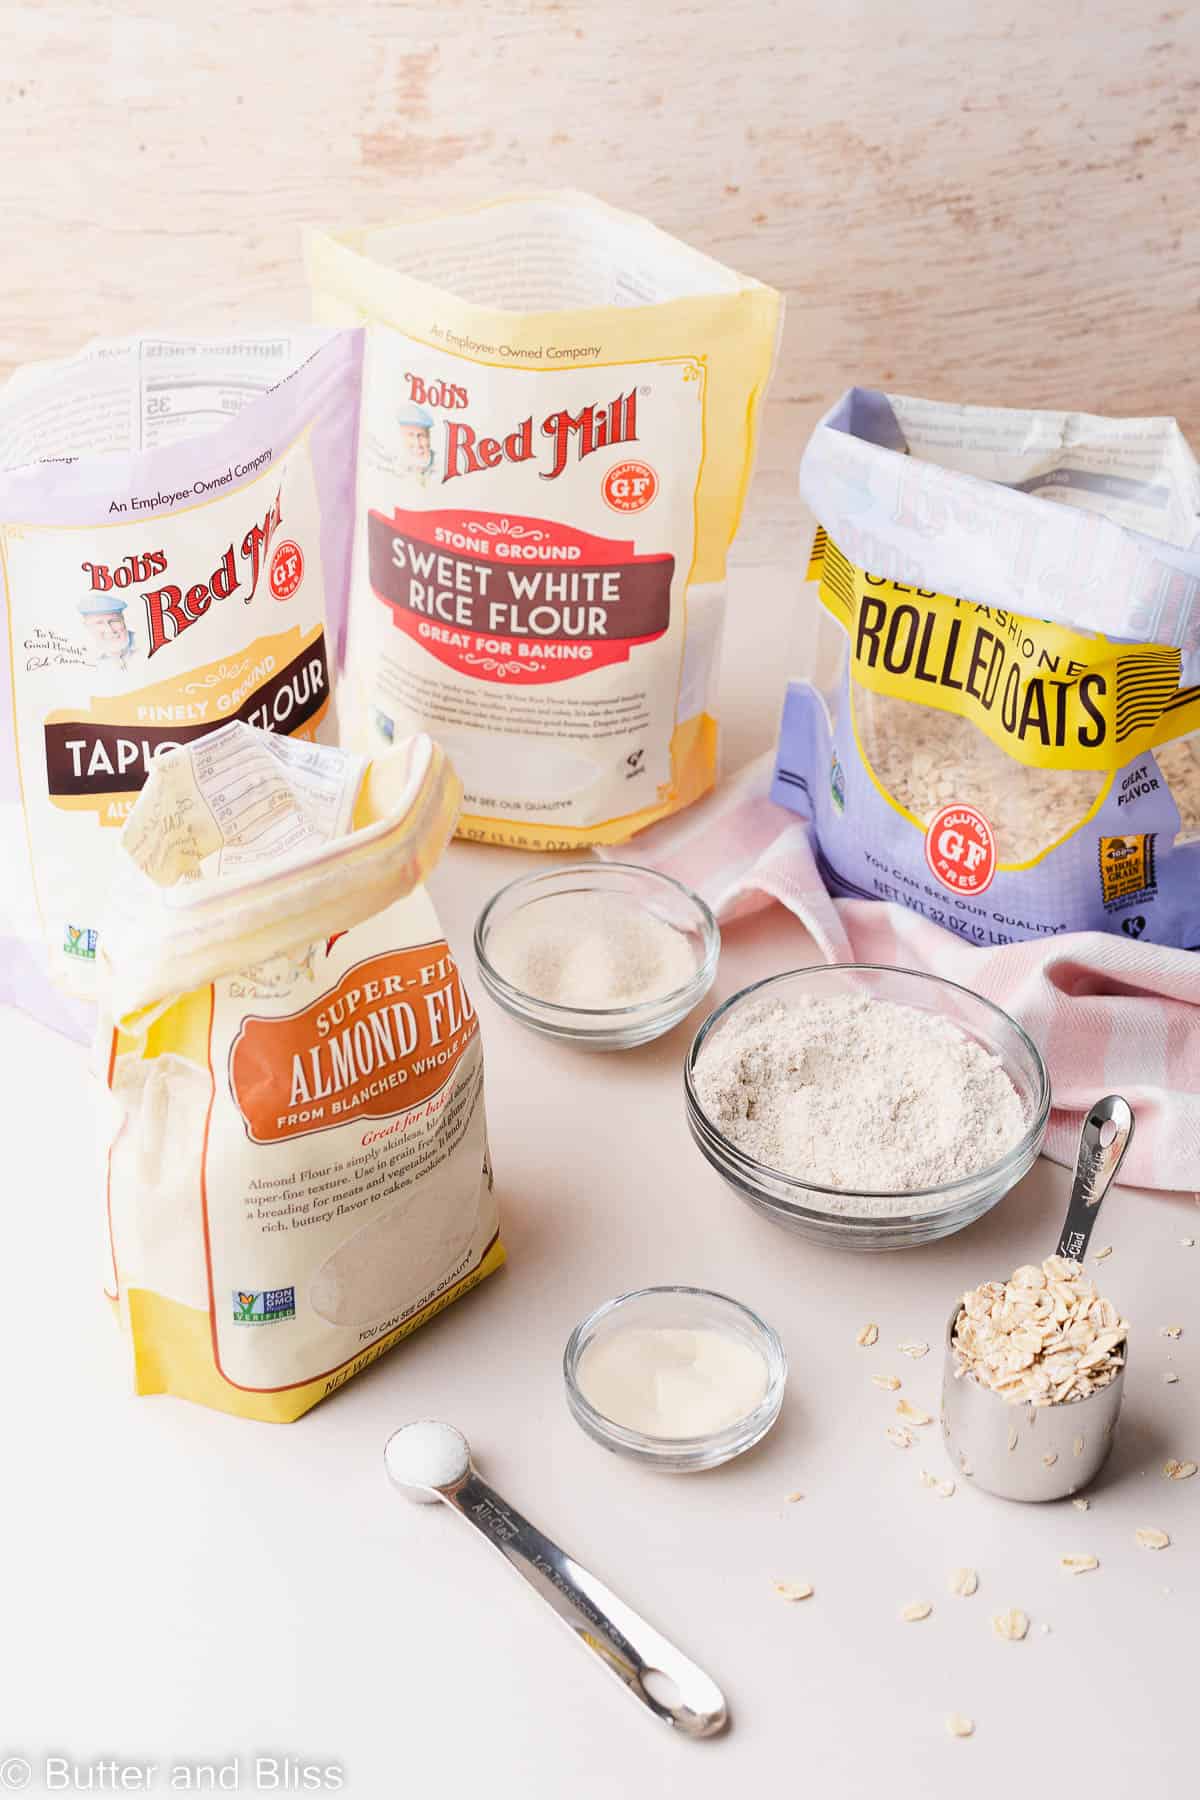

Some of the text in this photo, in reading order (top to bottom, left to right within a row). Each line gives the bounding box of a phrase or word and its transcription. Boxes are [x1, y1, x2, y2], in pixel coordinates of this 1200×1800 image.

[545, 346, 602, 361] Company
[404, 372, 470, 411] Bob's
[441, 415, 536, 485] Red
[108, 448, 274, 514] An Employee-Owned Company
[610, 478, 651, 497] GF
[434, 528, 581, 561] STONE GROUND
[81, 549, 169, 593] Bob's
[272, 555, 299, 587] GF
[392, 538, 622, 603] SWEET WHITE
[140, 544, 242, 659] Red
[409, 584, 608, 636] RICE FLOUR
[418, 622, 593, 661] GREAT FOR BAKING
[137, 655, 277, 722] FINELY GROUND
[855, 595, 1108, 749] ROLLED OATS
[248, 659, 324, 733] FLOUR
[937, 829, 987, 872] GF
[943, 812, 989, 846] GLUTEN
[863, 851, 889, 873] YOU
[892, 869, 920, 889] CAN
[924, 886, 951, 904] SEE
[954, 899, 988, 918] OUR
[936, 860, 978, 888] FREE
[873, 879, 900, 903] NET
[904, 895, 926, 915] WT
[929, 906, 945, 926] 32
[949, 916, 971, 935] OZ
[288, 1001, 418, 1107] ALMOND
[276, 1109, 325, 1130] FROM
[331, 1070, 409, 1115] BLANCHED
[411, 1041, 459, 1077] WHOLE
[361, 1119, 401, 1147] Great
[401, 1111, 423, 1133] for
[243, 1188, 305, 1207] super-fine
[354, 1166, 376, 1181] Use
[389, 1145, 416, 1167] grain
[248, 1173, 297, 1191] Almond
[300, 1166, 333, 1183] Flour
[346, 1146, 381, 1169] simply
[257, 1202, 311, 1220] breading
[313, 1196, 331, 1209] for
[332, 1185, 364, 1203] meats
[366, 1172, 386, 1191] and
[291, 1209, 335, 1230] buttery
[336, 1197, 370, 1217] flavor
[370, 1191, 381, 1203] to
[378, 1315, 400, 1333] CAN
